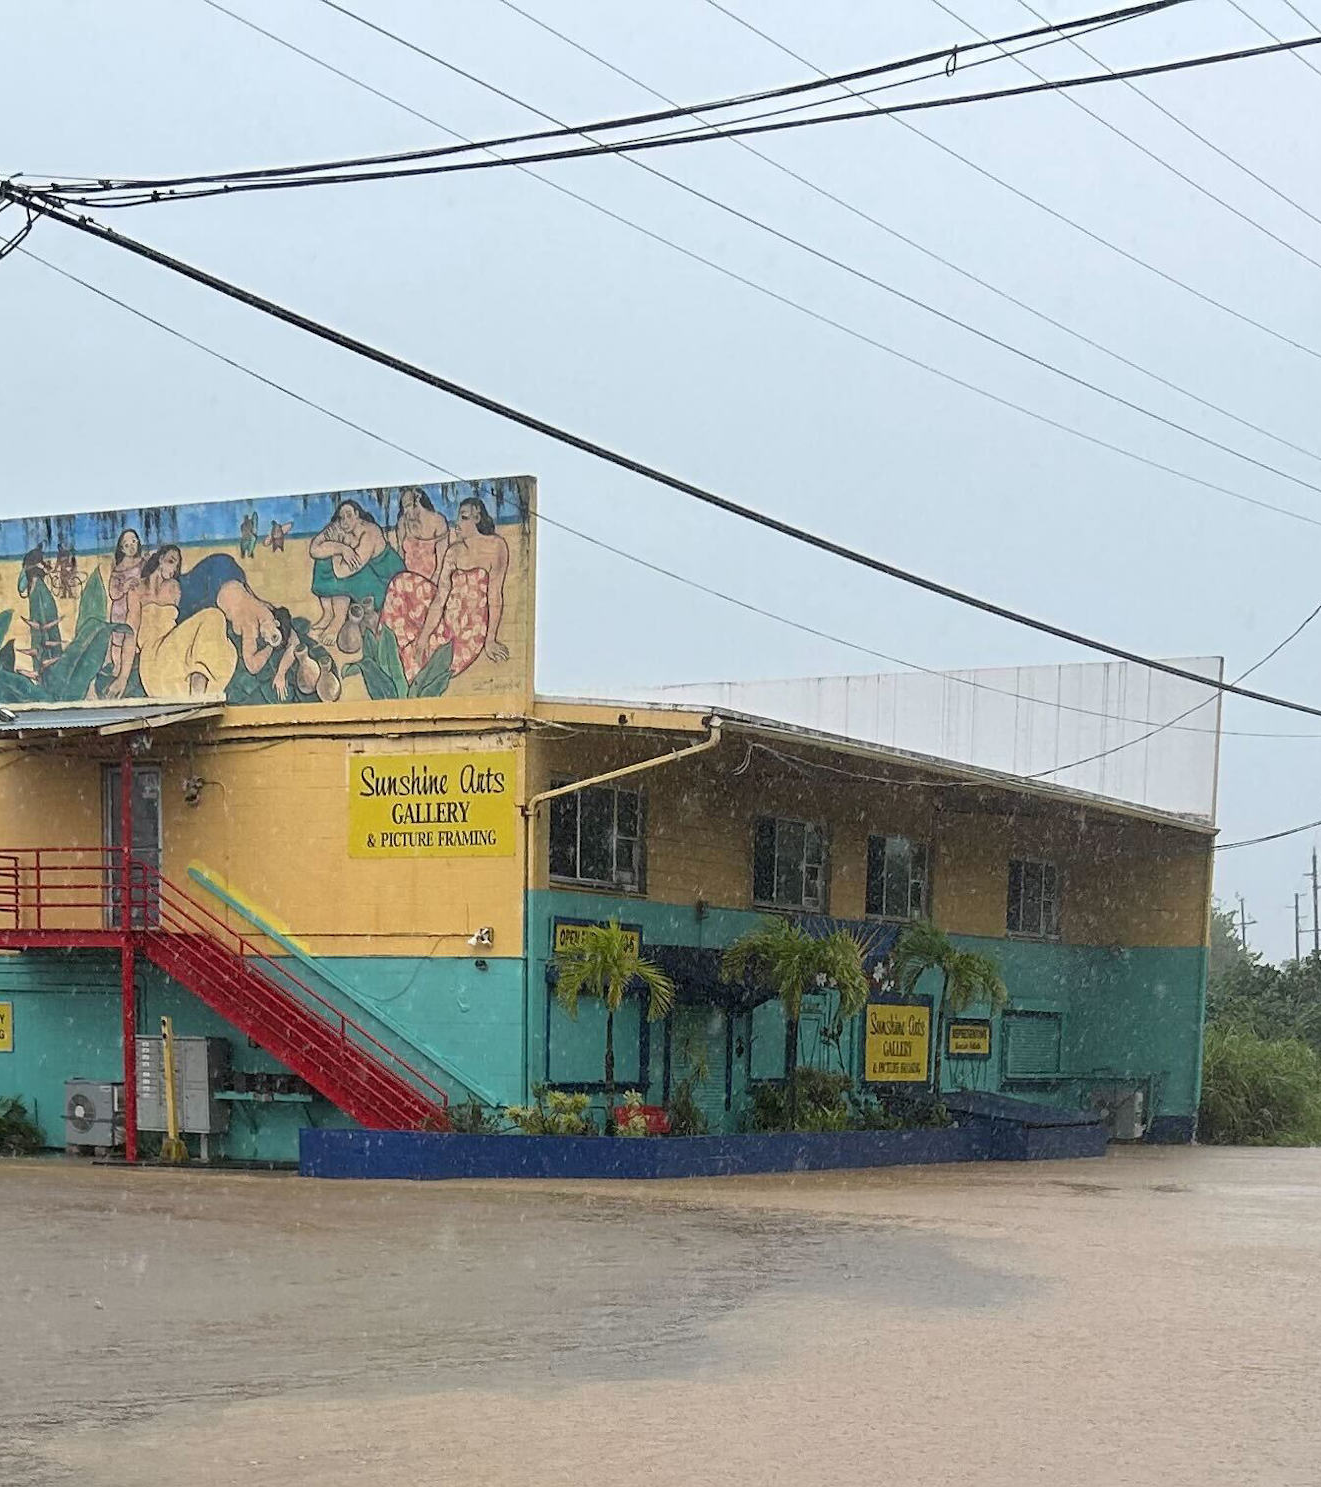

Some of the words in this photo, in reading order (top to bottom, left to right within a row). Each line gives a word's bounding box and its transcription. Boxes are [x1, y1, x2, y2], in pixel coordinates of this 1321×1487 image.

[359, 765, 448, 796] Sunshine
[460, 764, 505, 794] Arts
[392, 801, 470, 824] GALLERY
[366, 832, 376, 848] &
[381, 831, 433, 847] PICTURE
[438, 830, 496, 846] FRAMING
[870, 1012, 904, 1035] Sunshine
[883, 1040, 912, 1057] GALLERY
